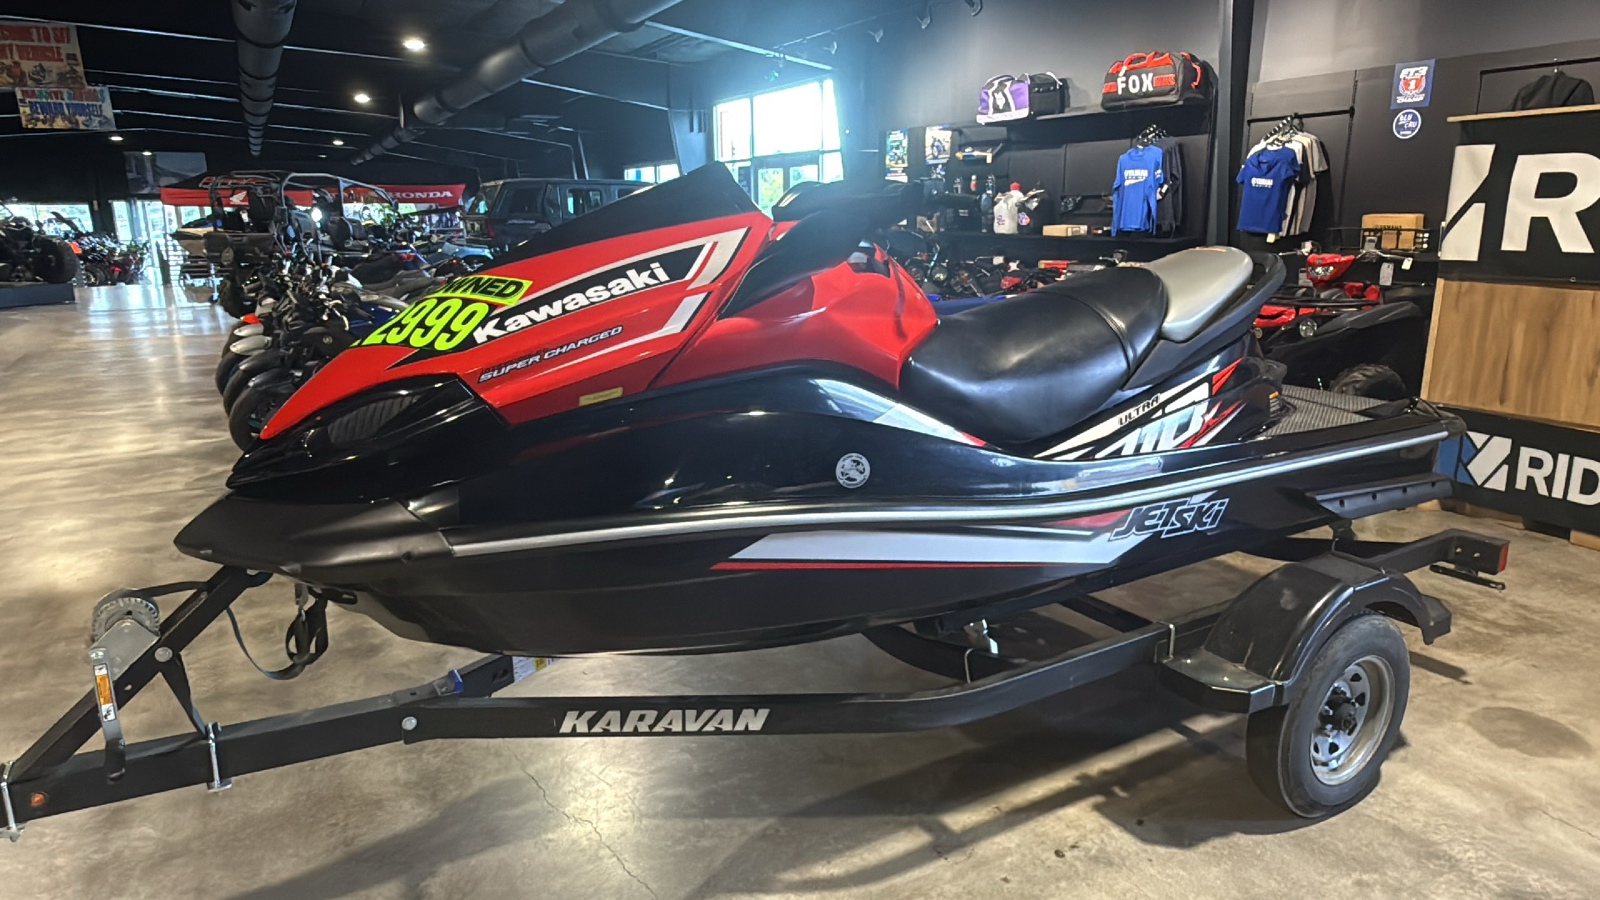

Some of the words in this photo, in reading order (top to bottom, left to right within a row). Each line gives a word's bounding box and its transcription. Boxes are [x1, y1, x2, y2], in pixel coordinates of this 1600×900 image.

[1117, 73, 1154, 95] FOX
[1408, 79, 1417, 90] 1
[1404, 121, 1417, 129] CRU
[387, 190, 453, 200] HONDA
[472, 261, 670, 344] Kawasaki
[478, 354, 541, 383] SUPER
[543, 325, 624, 359] CHARGED
[1119, 393, 1161, 426] ULTRA
[1515, 446, 1600, 506] RID
[559, 708, 770, 733] KARAVAN
